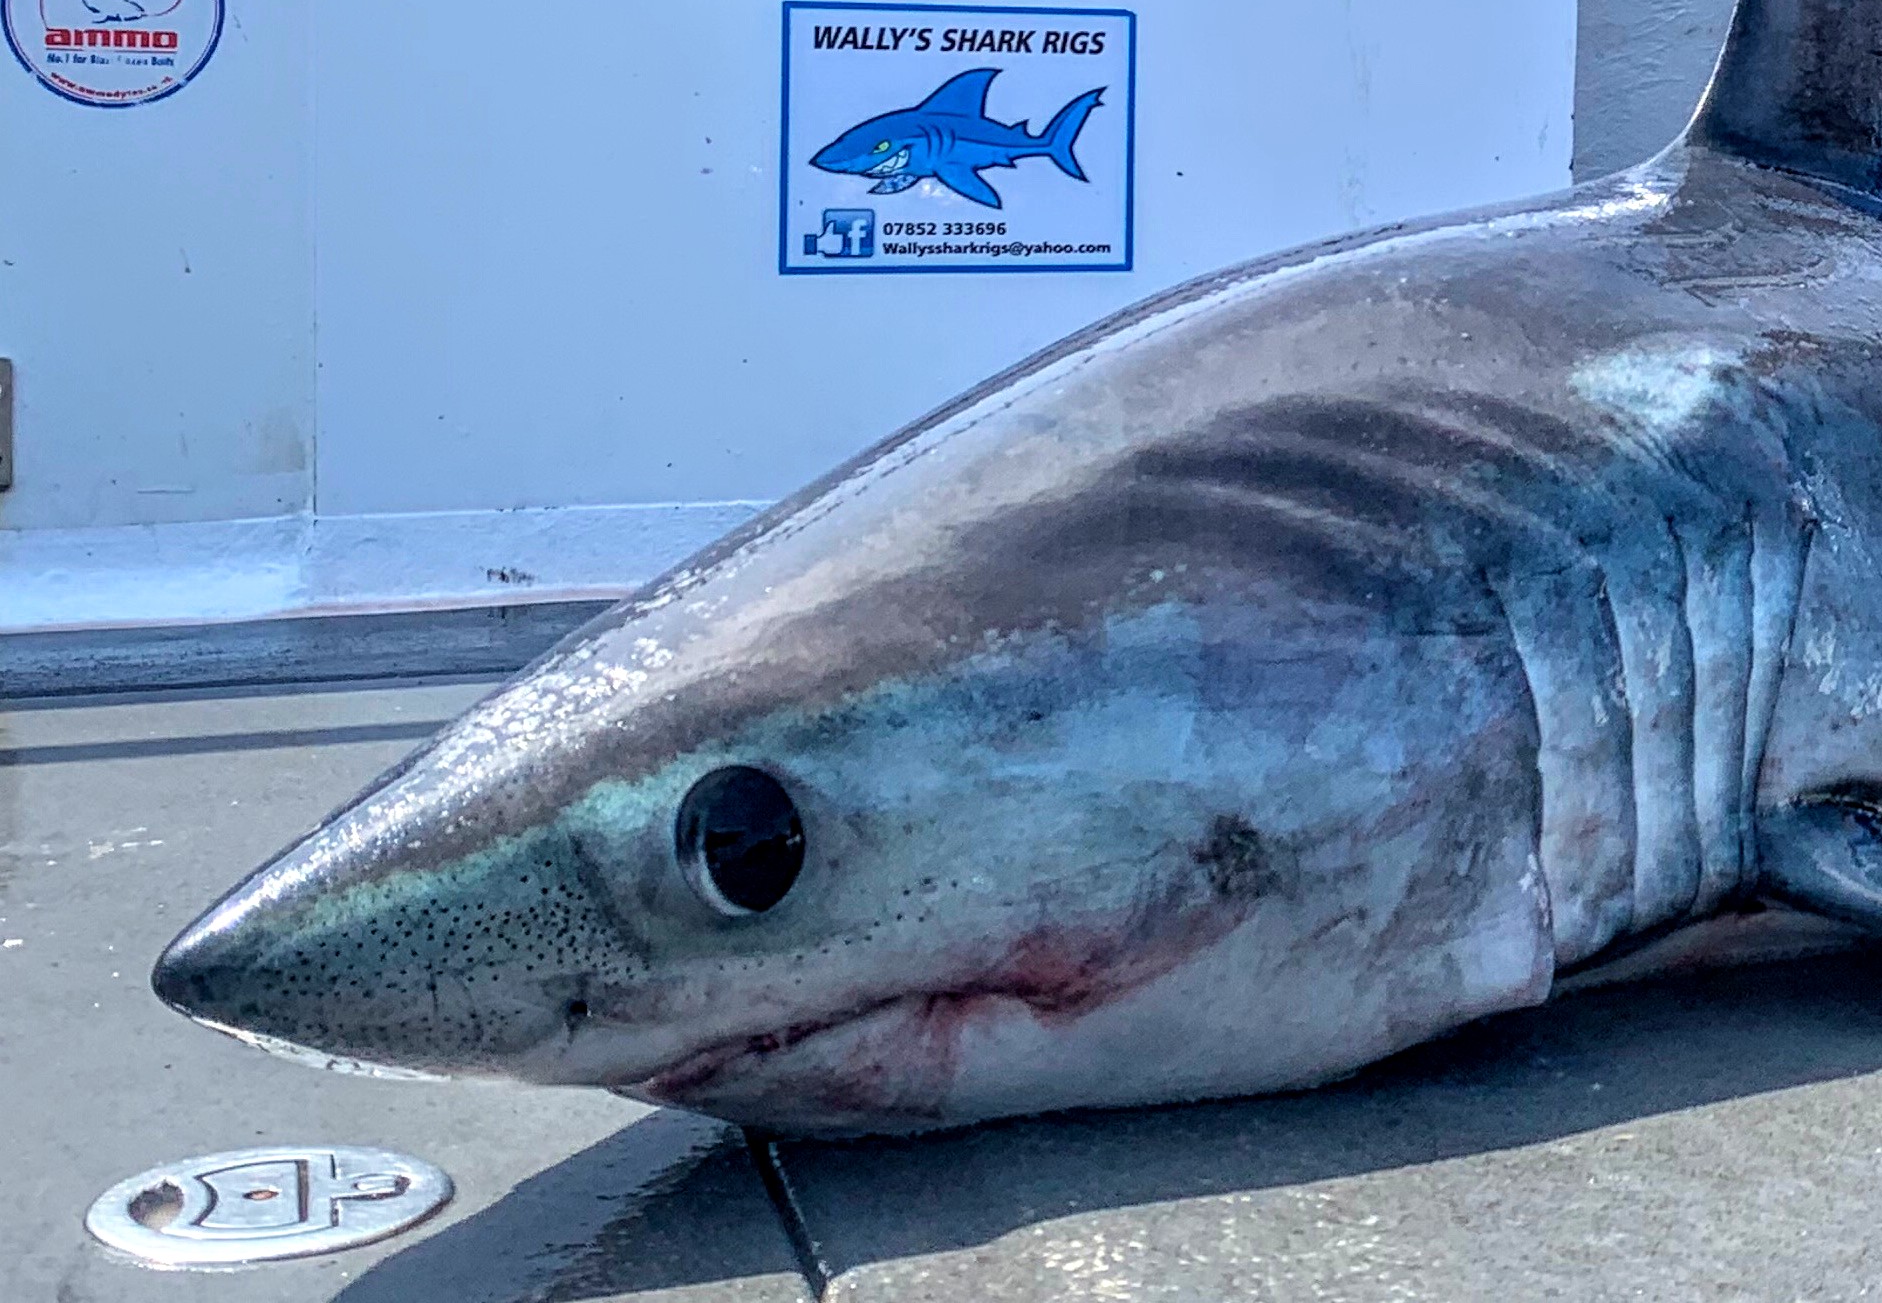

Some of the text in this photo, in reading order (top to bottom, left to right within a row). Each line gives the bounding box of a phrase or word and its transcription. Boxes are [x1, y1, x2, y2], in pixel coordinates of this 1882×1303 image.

[45, 29, 178, 48] ammo
[813, 26, 1106, 55] WALLY'S SHARK RIGS
[73, 53, 87, 65] for
[882, 222, 1007, 236] 07852 333696
[882, 241, 1112, 257] Wallyssharkrigs@yahoo.com
